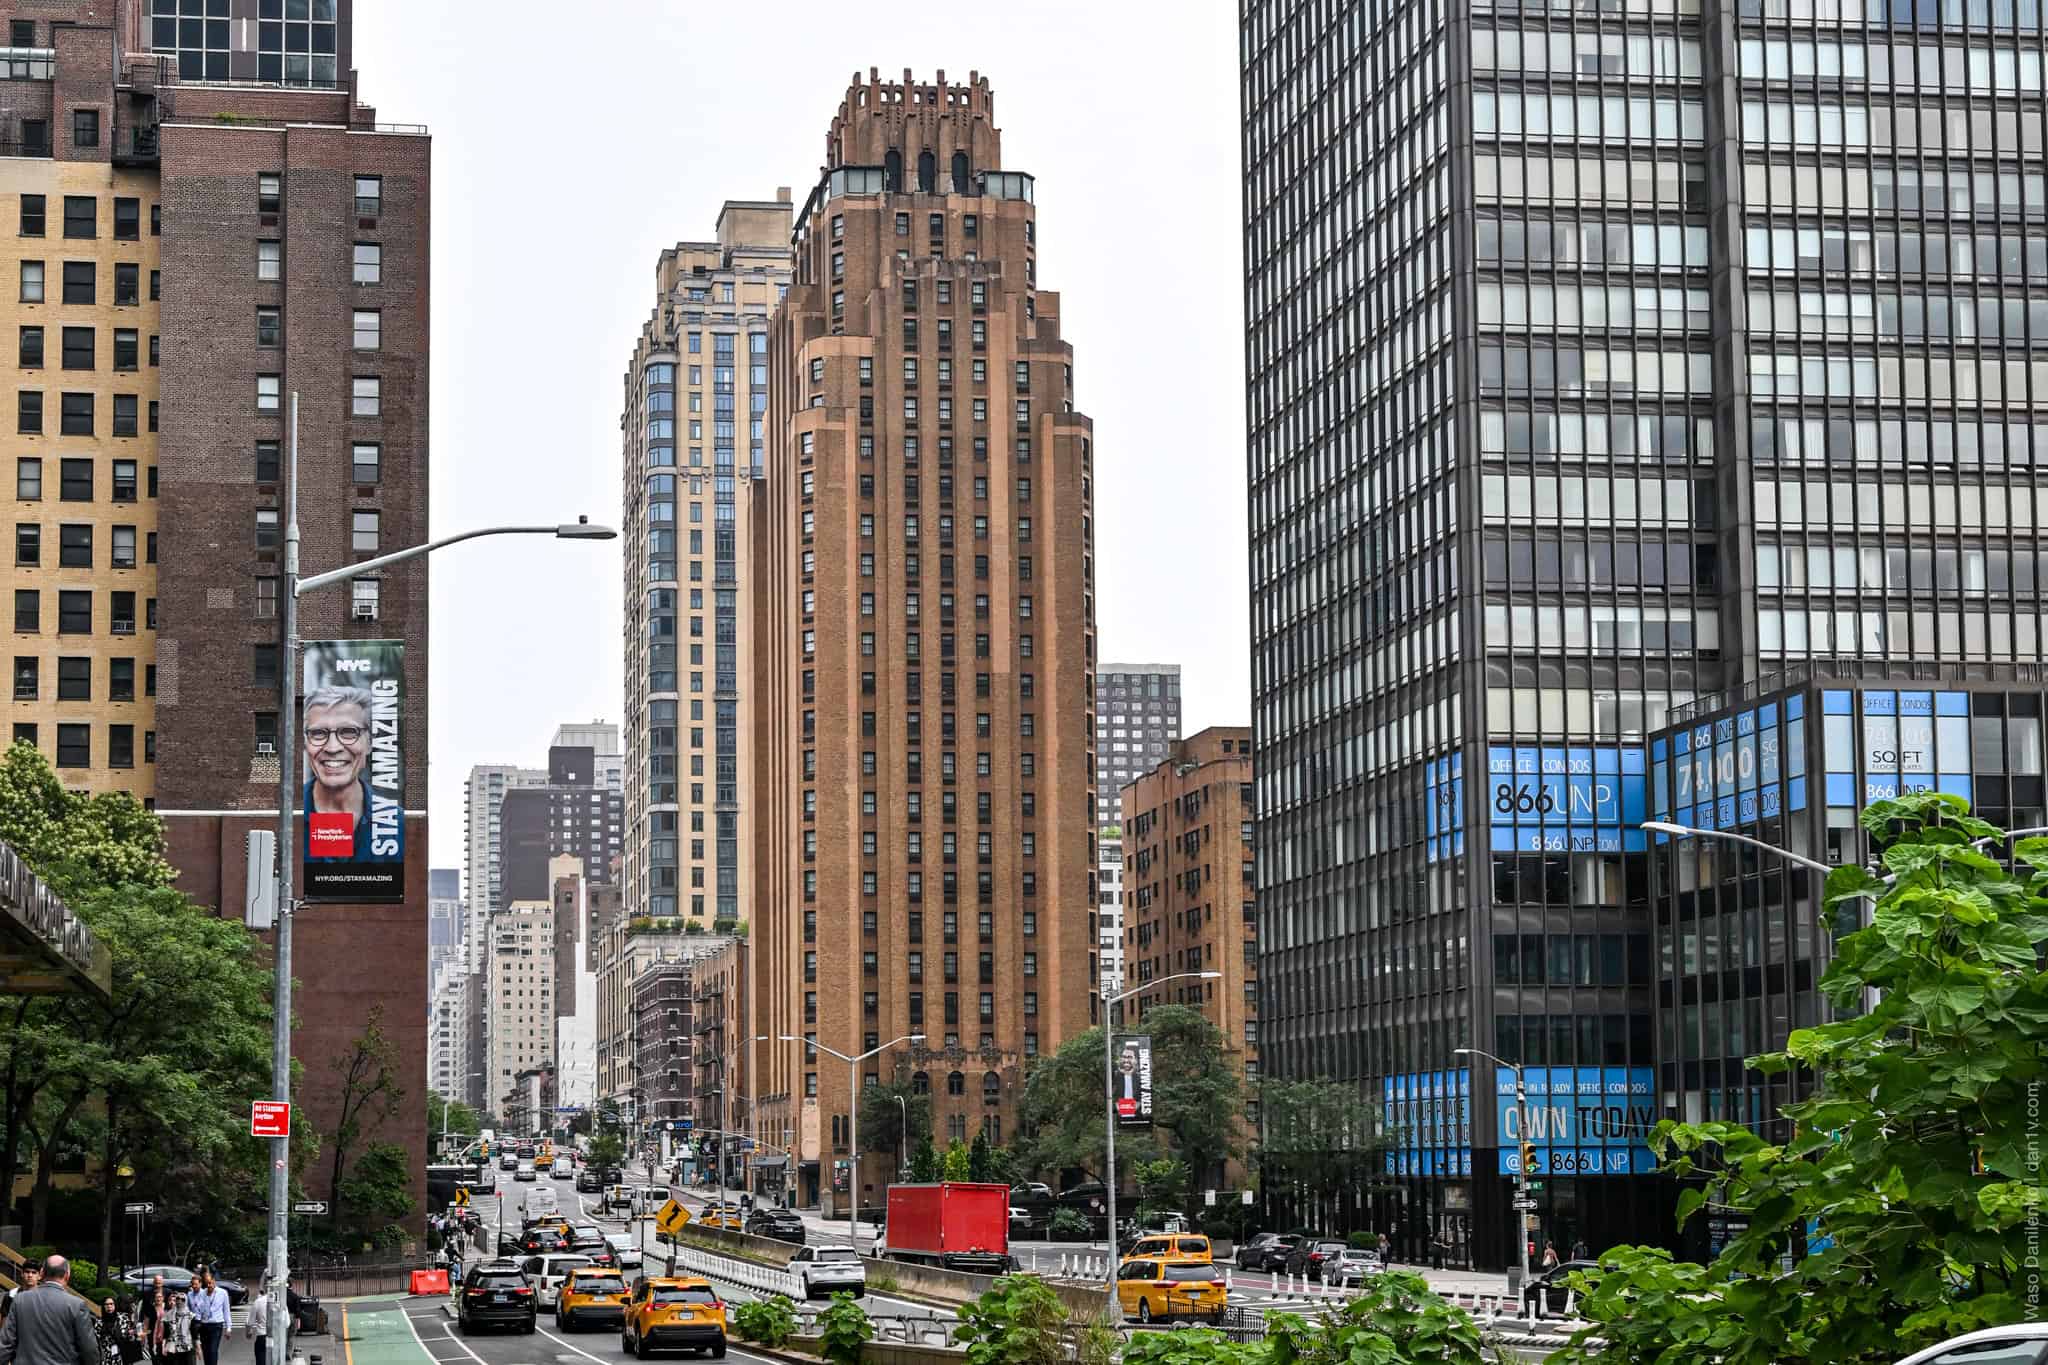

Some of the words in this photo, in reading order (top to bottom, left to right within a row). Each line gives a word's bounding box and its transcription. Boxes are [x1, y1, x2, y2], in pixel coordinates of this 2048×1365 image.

[336, 659, 371, 671] NYC
[371, 680, 399, 789] AMAZING
[1872, 750, 1897, 764] SQ
[1903, 750, 1923, 764] FT
[1495, 783, 1611, 815] 866UNP
[371, 795, 399, 856] STAY
[1139, 1048, 1151, 1090] AMAZING
[1141, 1091, 1152, 1115] STAY
[1504, 1106, 1568, 1139] OWN
[1577, 1106, 1654, 1139] TODAY
[1551, 1152, 1629, 1172] 866UNP
